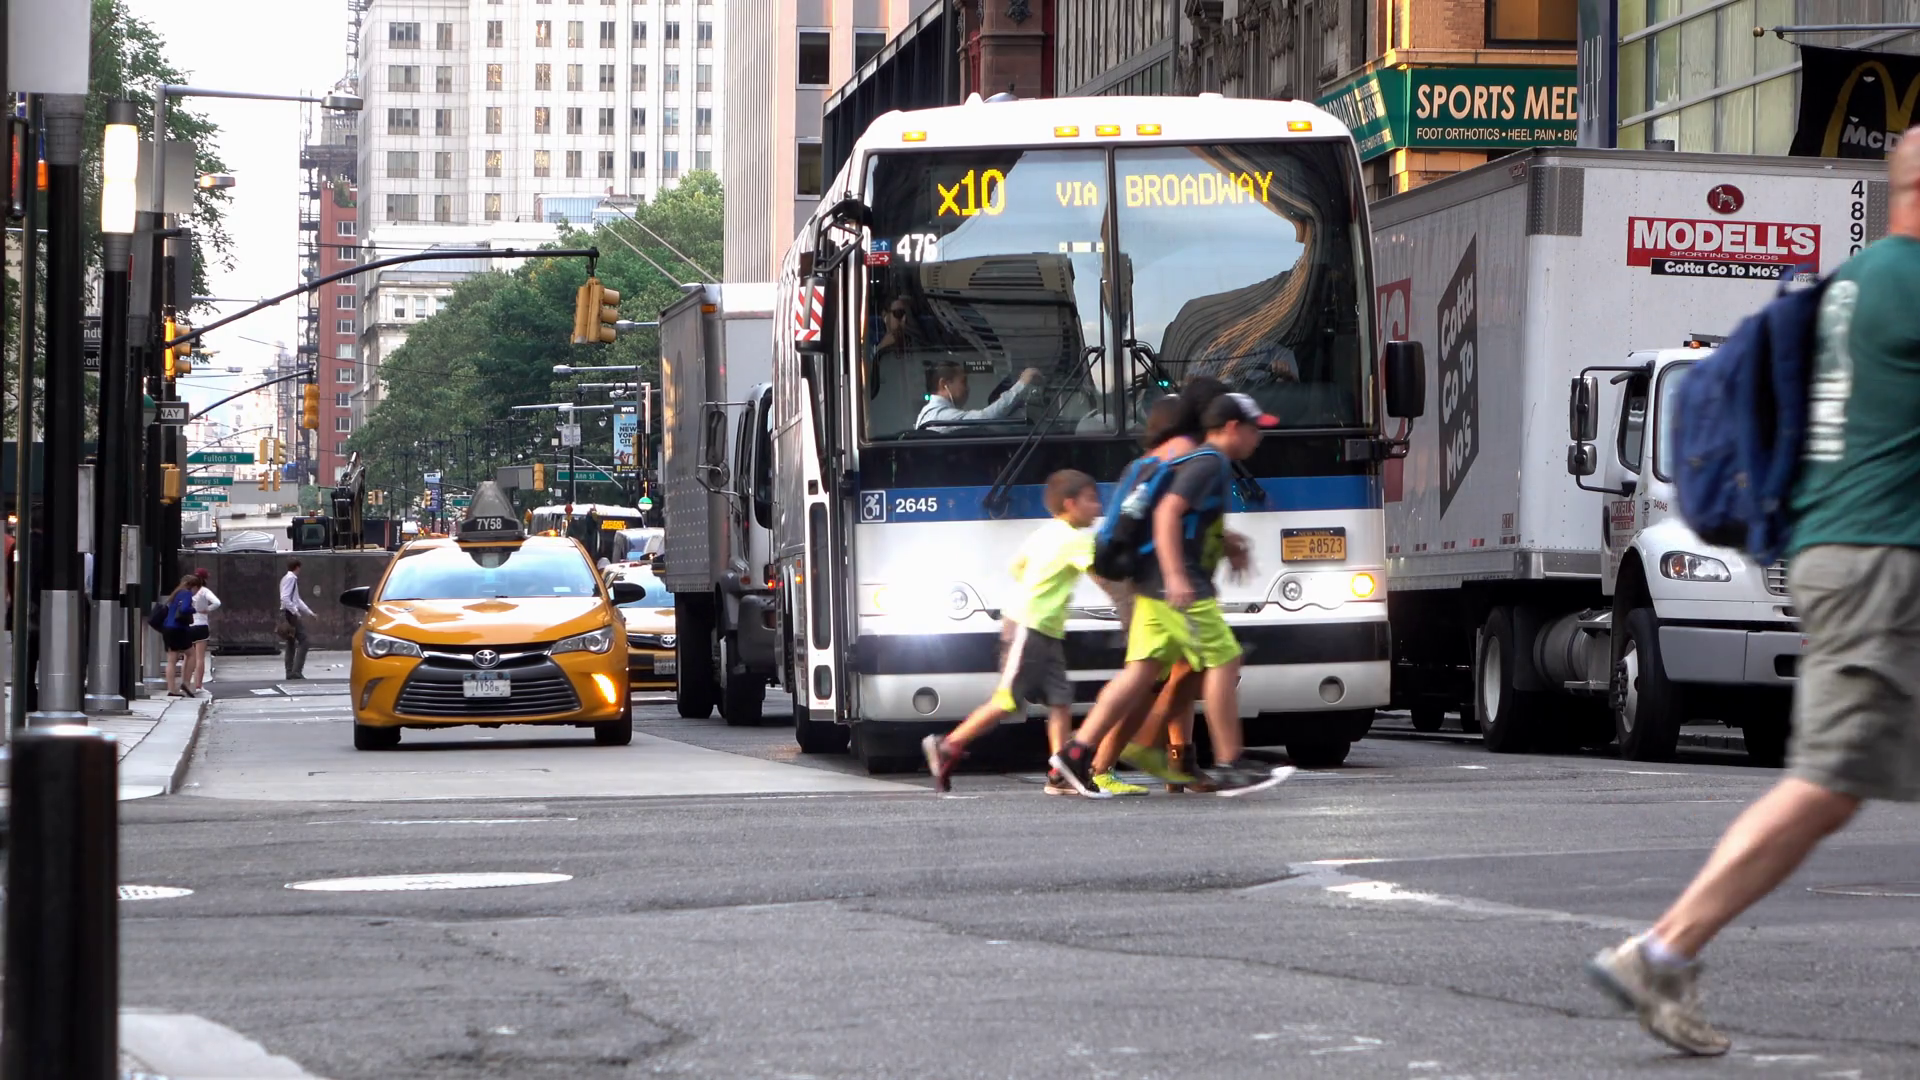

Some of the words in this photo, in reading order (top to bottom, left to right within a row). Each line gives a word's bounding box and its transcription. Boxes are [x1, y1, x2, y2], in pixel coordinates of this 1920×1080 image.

[1416, 84, 1515, 121] SPORTS
[1523, 85, 1577, 120] MED
[1416, 127, 1443, 140] FOOT
[1445, 127, 1500, 140] ORTHOTICS
[1507, 129, 1532, 141] HEEL
[1534, 129, 1556, 141] PAIN
[1056, 181, 1098, 207] VIA
[1125, 171, 1273, 207] BROADWAY
[896, 233, 938, 263] 476
[1633, 219, 1816, 255] MODELL'S
[1664, 261, 1704, 274] Gotta
[1707, 262, 1727, 275] Go
[1729, 264, 1746, 276] To
[1749, 265, 1780, 278] Mo's
[1669, 251, 1730, 259] SPORTING
[1441, 272, 1474, 361] Gotta
[1442, 369, 1459, 424] Go
[1459, 340, 1474, 392] To
[1446, 411, 1472, 490] Mo's
[896, 497, 938, 513] 2645
[477, 518, 502, 530] 7Y58
